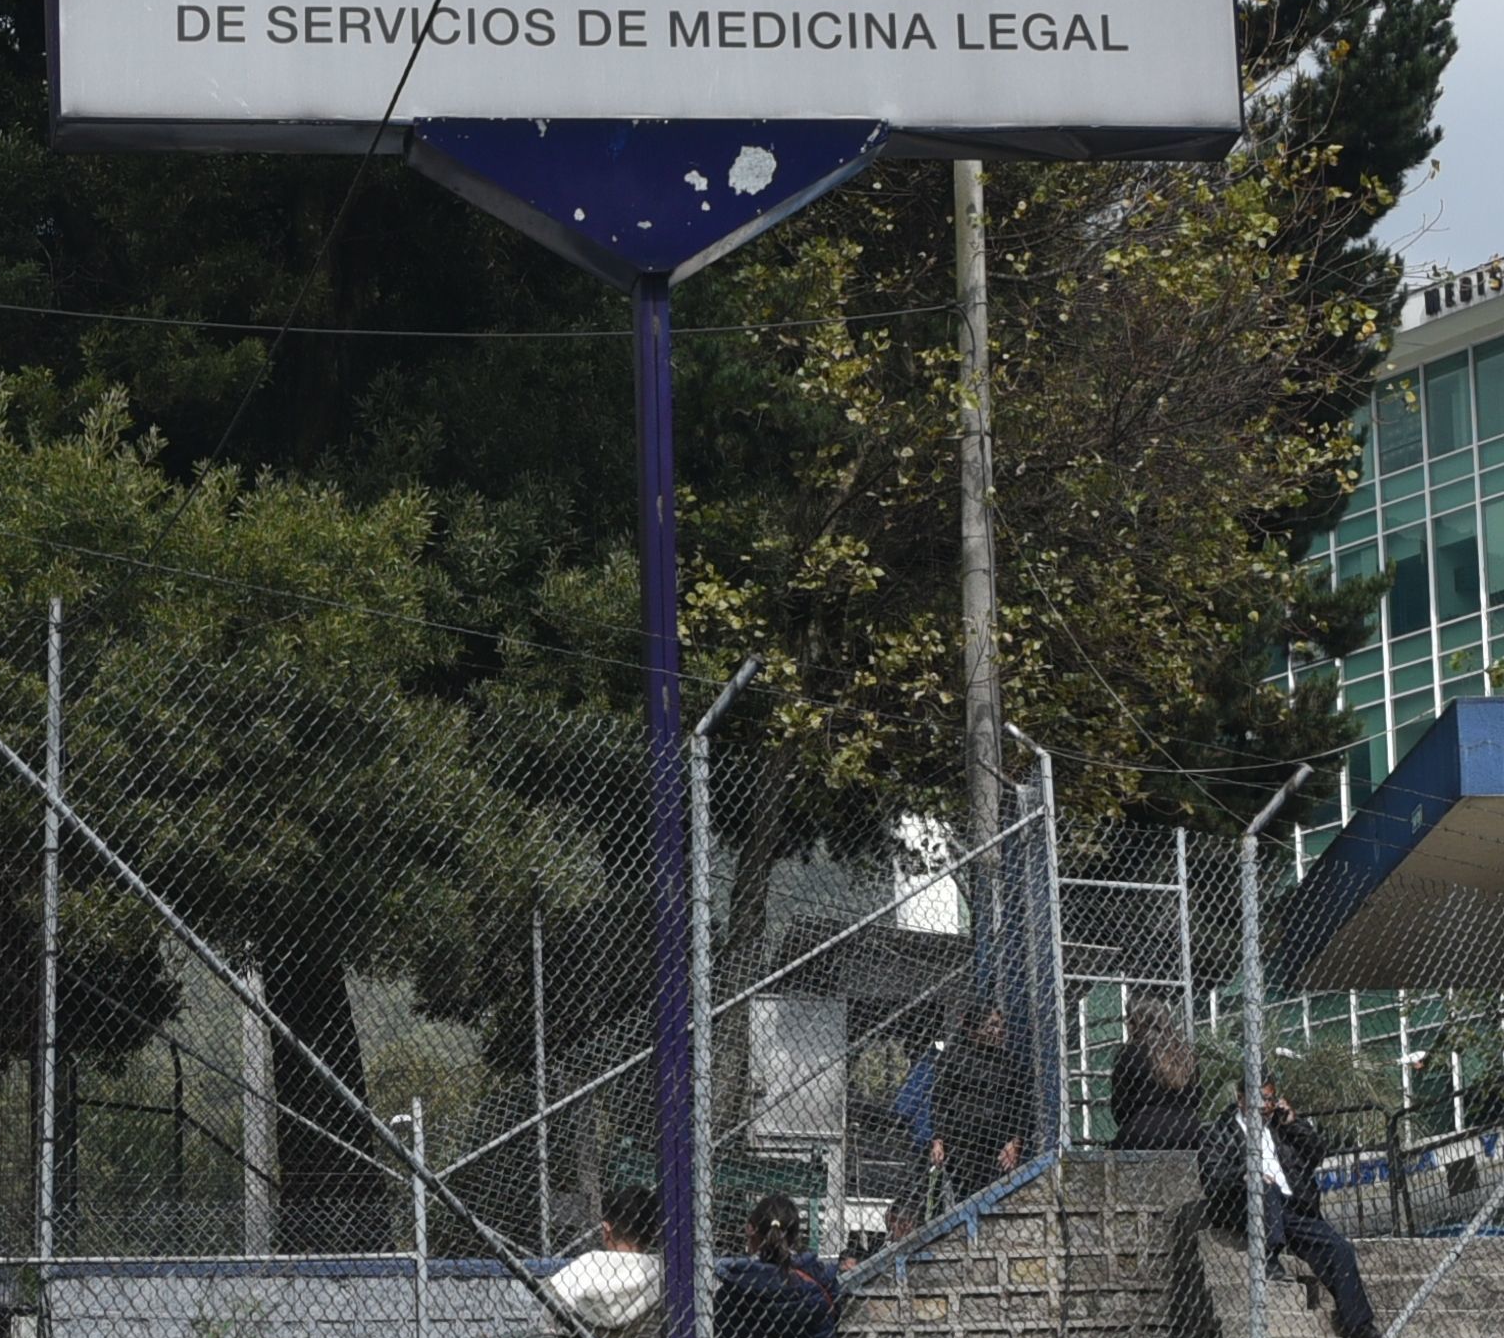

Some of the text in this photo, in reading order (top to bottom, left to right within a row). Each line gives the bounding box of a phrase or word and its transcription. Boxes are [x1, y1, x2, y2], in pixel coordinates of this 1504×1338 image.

[176, 5, 1129, 54] DE SERVICIOS DE MEDICINA LEGAL
